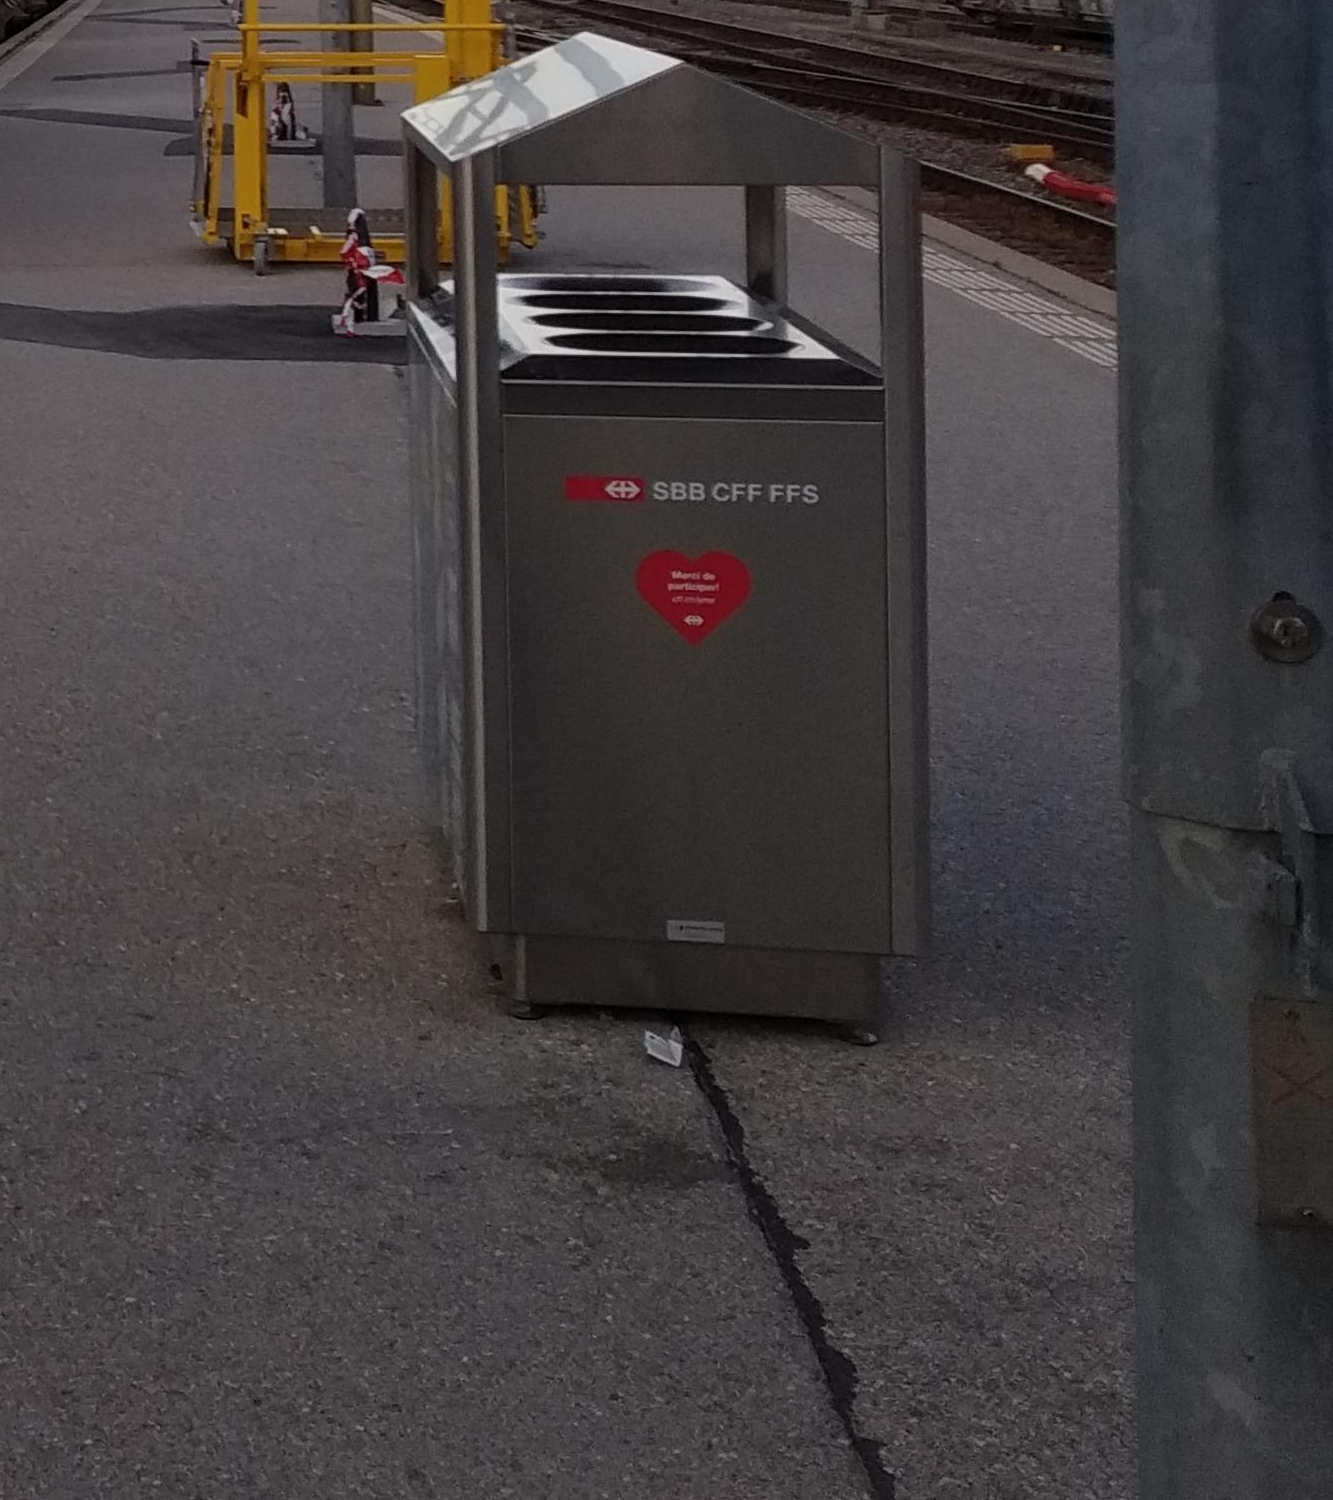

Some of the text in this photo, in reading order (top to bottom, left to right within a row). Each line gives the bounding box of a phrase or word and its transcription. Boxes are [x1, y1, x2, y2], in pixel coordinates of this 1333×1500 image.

[653, 481, 820, 503] SBB CFF FFS
